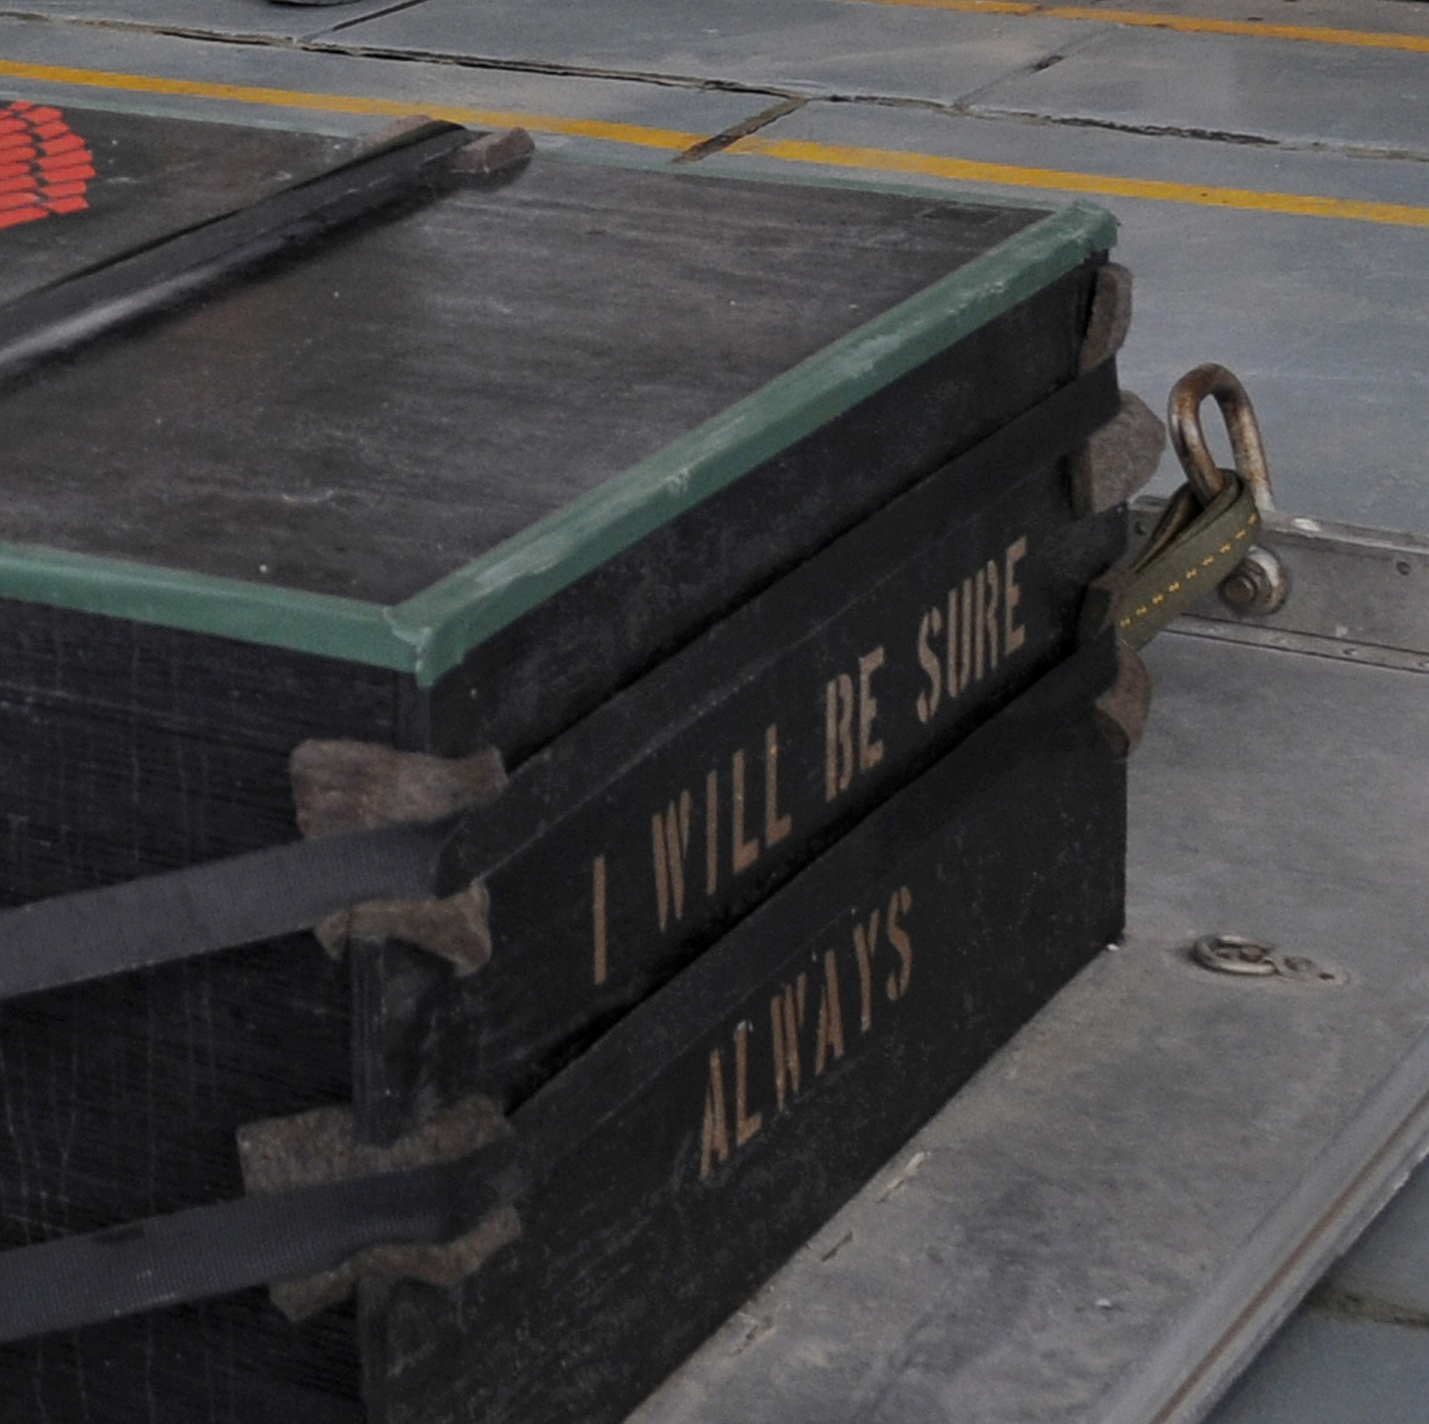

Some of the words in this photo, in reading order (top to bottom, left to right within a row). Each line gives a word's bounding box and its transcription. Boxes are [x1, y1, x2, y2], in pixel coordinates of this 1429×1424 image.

[593, 854, 608, 985] I
[652, 723, 792, 933] WILL
[825, 646, 885, 802] BE
[916, 535, 1028, 725] SURE
[698, 885, 914, 1180] ALWAYS
